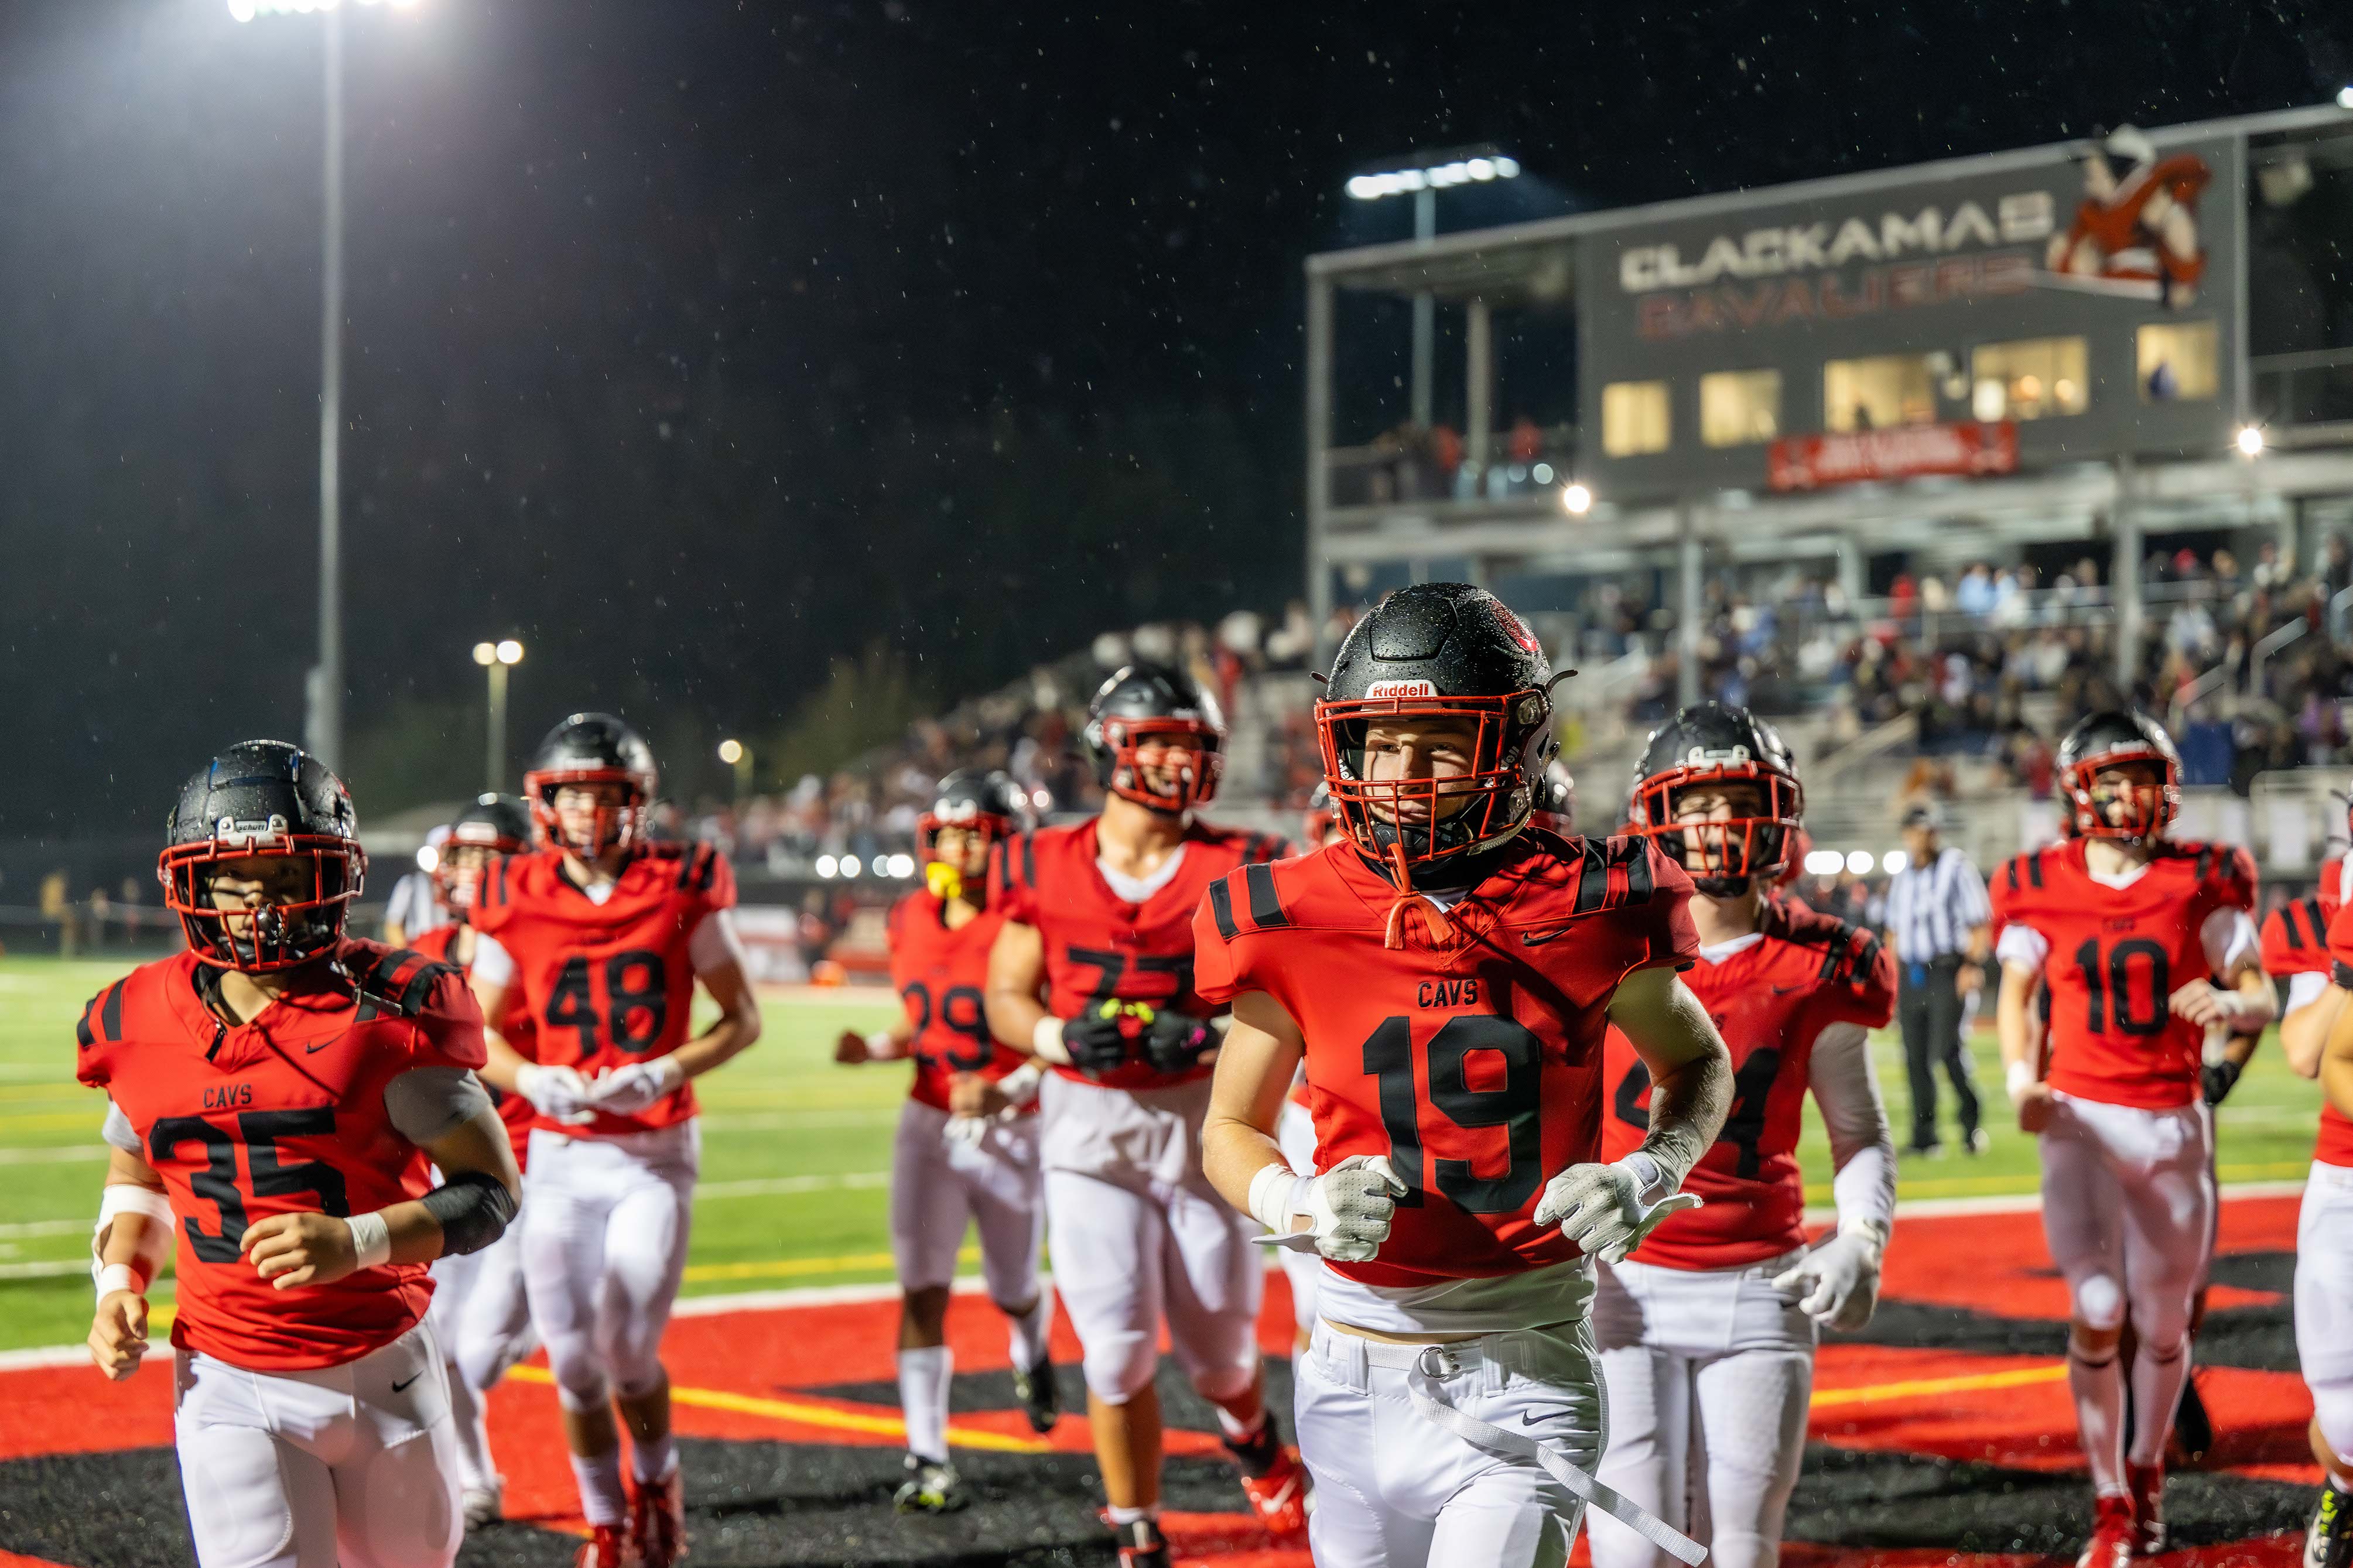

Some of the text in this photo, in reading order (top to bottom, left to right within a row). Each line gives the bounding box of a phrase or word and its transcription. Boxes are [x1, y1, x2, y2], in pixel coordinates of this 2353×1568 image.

[1620, 191, 2054, 292] CLACKAMAS
[1373, 683, 1428, 697] Riddell
[546, 951, 667, 1055] 48
[1418, 978, 1478, 1008] CAVS
[2076, 939, 2170, 1035] 10
[203, 1083, 252, 1108] CAVS
[1362, 1014, 1543, 1215] 19
[149, 1106, 351, 1264] 35
